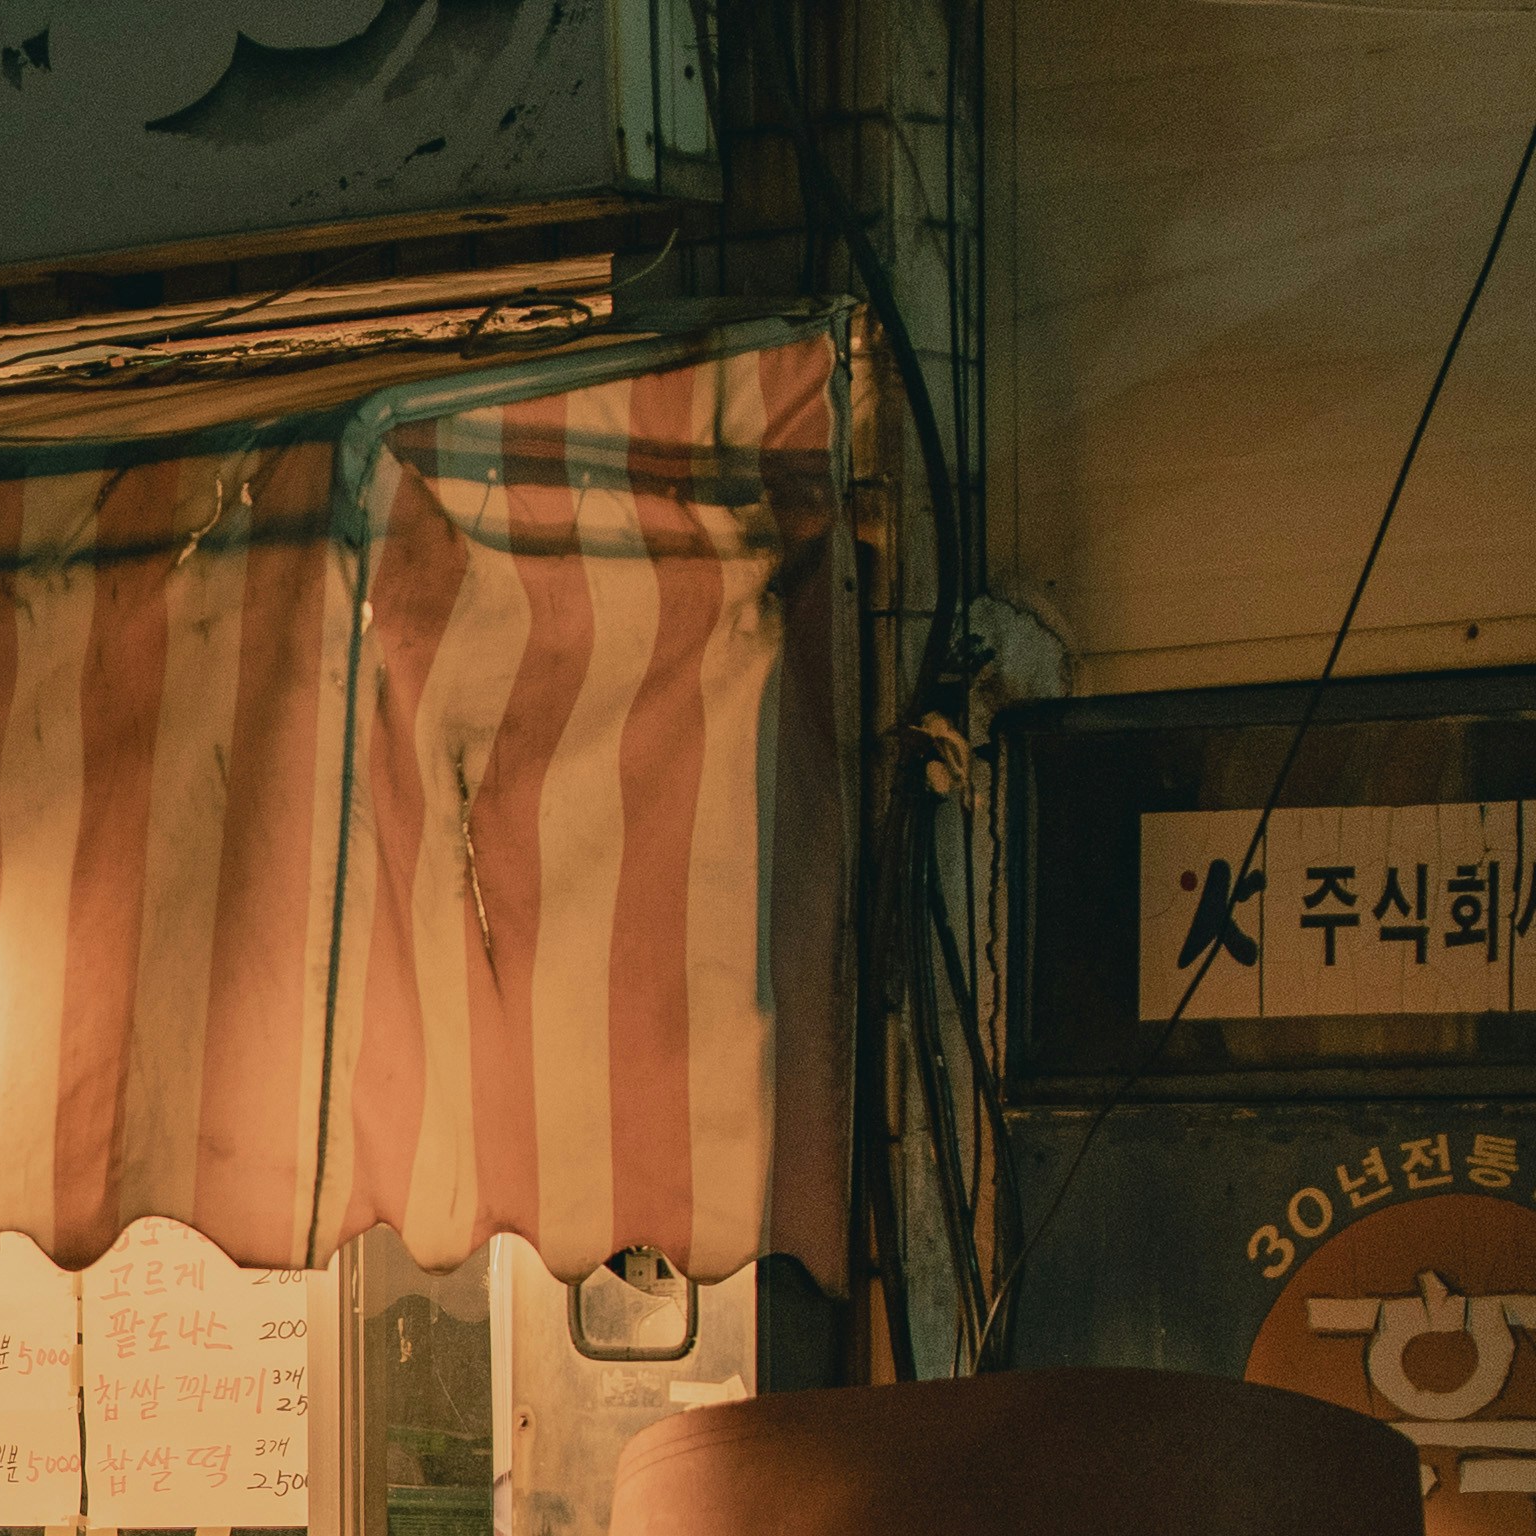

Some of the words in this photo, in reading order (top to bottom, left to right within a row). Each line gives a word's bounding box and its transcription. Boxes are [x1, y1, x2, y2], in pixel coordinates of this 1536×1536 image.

[1299, 861, 1536, 967] 주식회
[105, 1308, 233, 1359] 팥도나스
[17, 1341, 70, 1375] 5000
[273, 1367, 305, 1389] 3개
[255, 1437, 290, 1457] 3개
[26, 1450, 80, 1483] 5000
